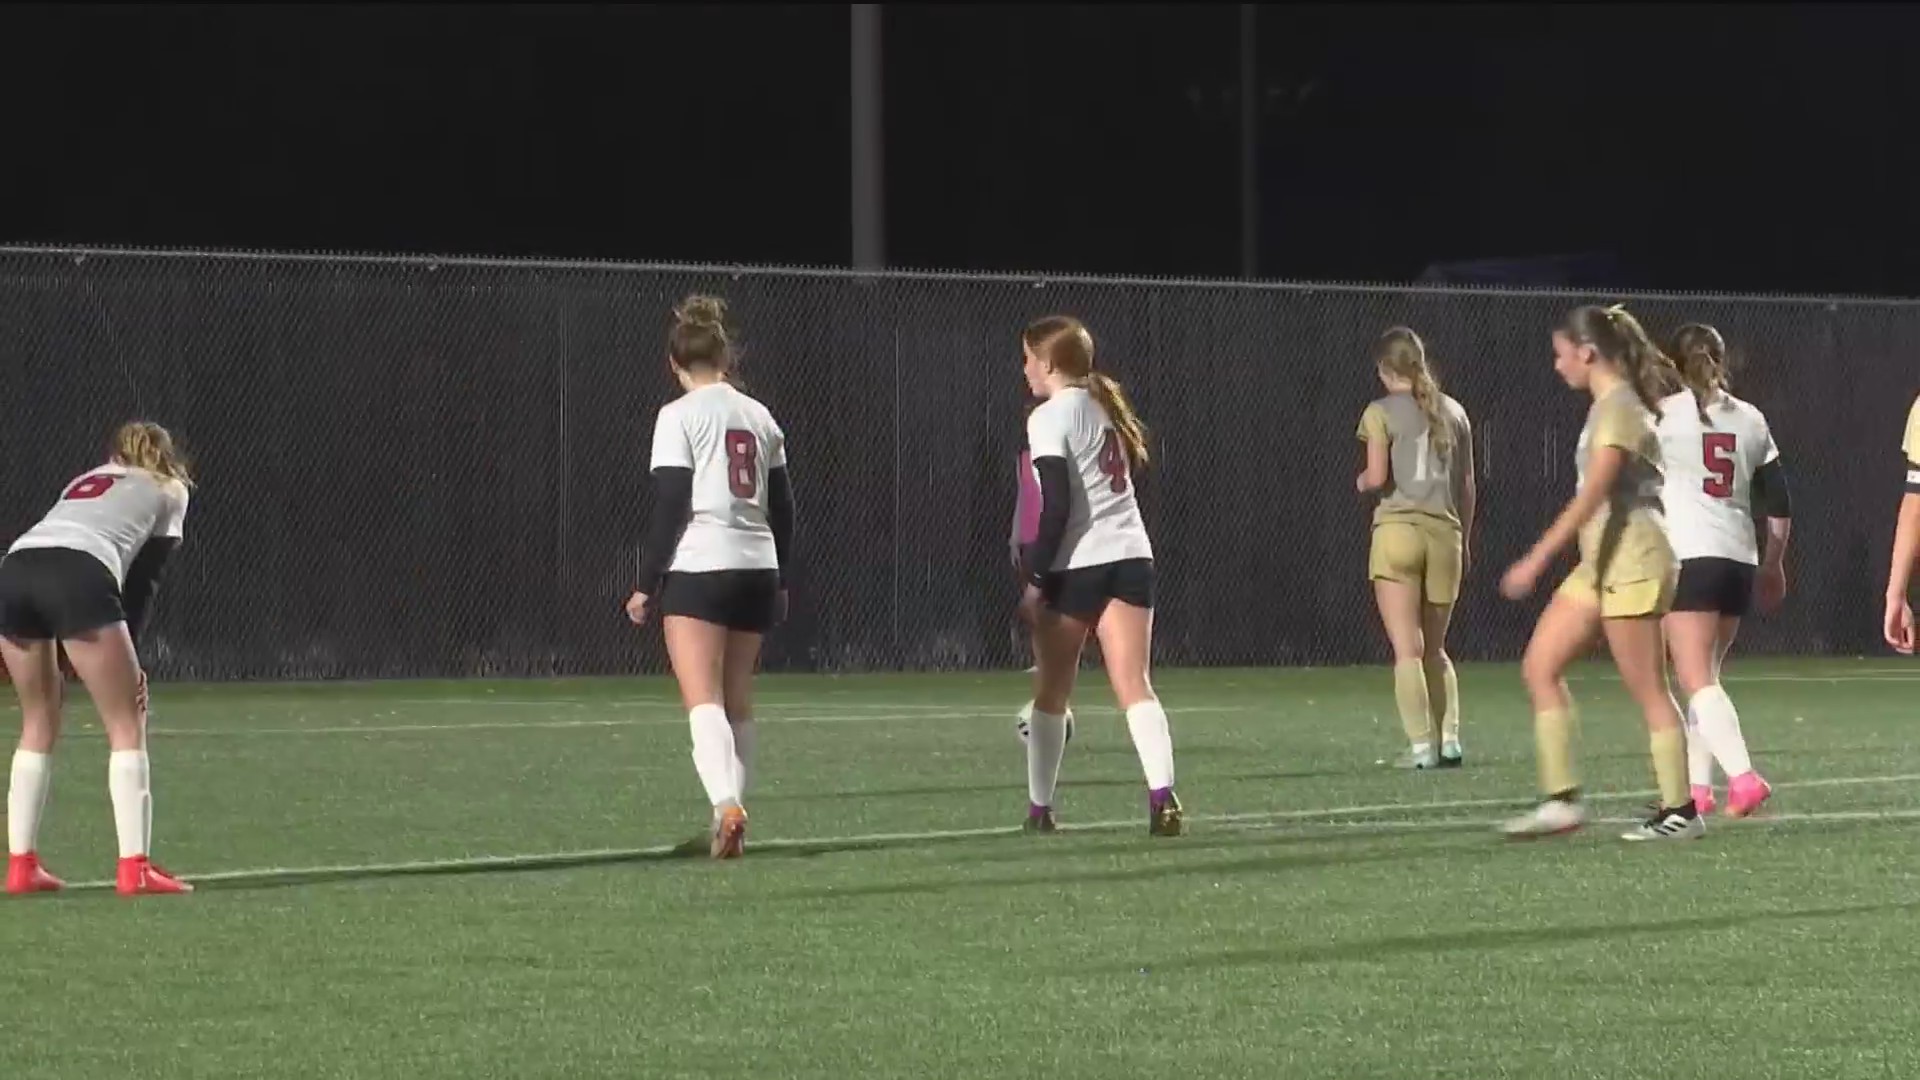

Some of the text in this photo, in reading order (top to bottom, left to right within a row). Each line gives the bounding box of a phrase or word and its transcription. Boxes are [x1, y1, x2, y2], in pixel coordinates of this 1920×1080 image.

[63, 474, 116, 500] 6
[725, 430, 757, 499] 8
[1098, 428, 1127, 494] 4
[1702, 432, 1737, 498] 5
